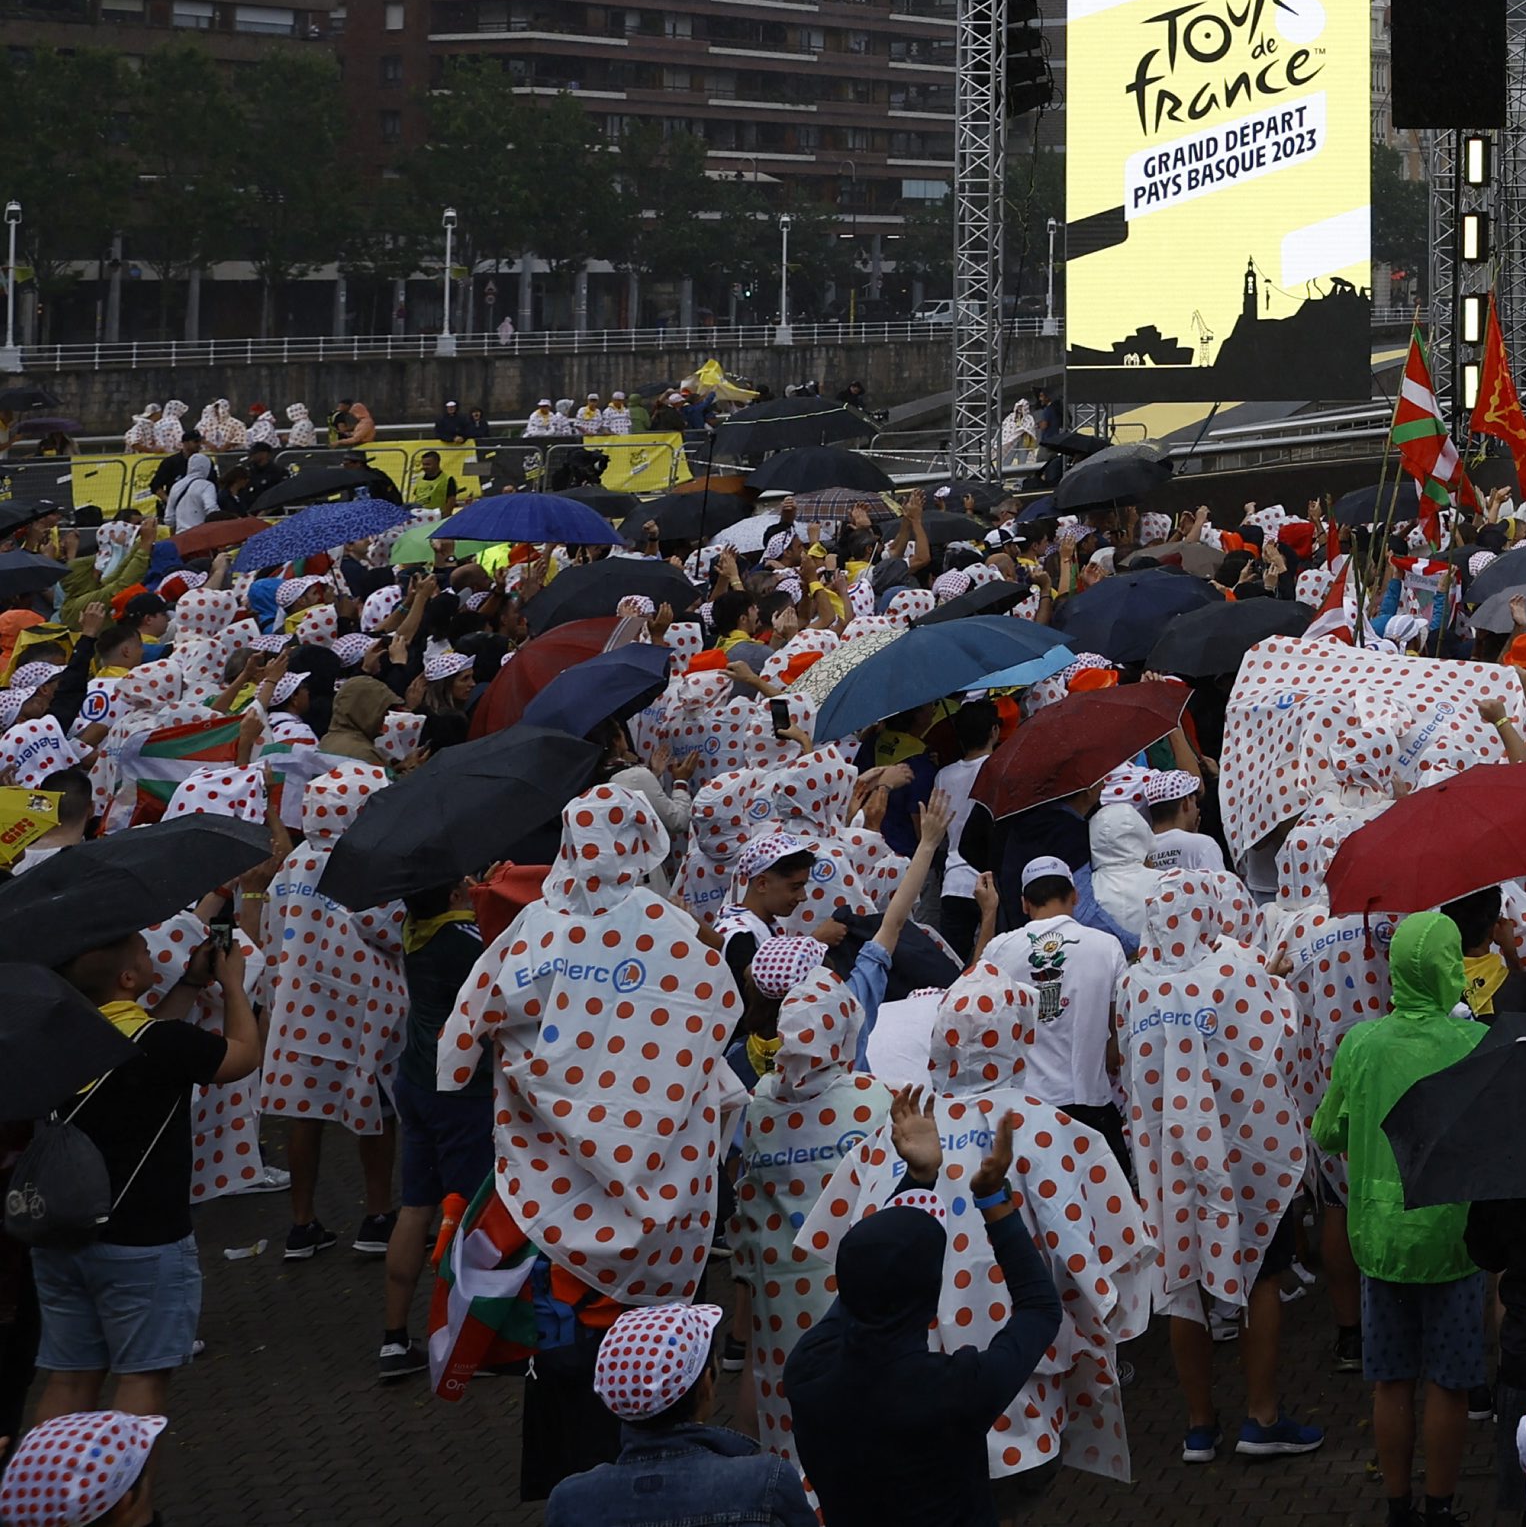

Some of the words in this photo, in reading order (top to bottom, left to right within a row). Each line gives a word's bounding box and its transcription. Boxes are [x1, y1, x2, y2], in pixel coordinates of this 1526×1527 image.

[1251, 31, 1278, 60] de
[1133, 173, 1183, 209] PAYS
[1187, 148, 1266, 193] BASQUE
[1271, 127, 1317, 164] 2023
[1143, 136, 1218, 179] GRAND
[1225, 106, 1308, 158] DÉPART
[1399, 713, 1444, 767] E.Leclerc
